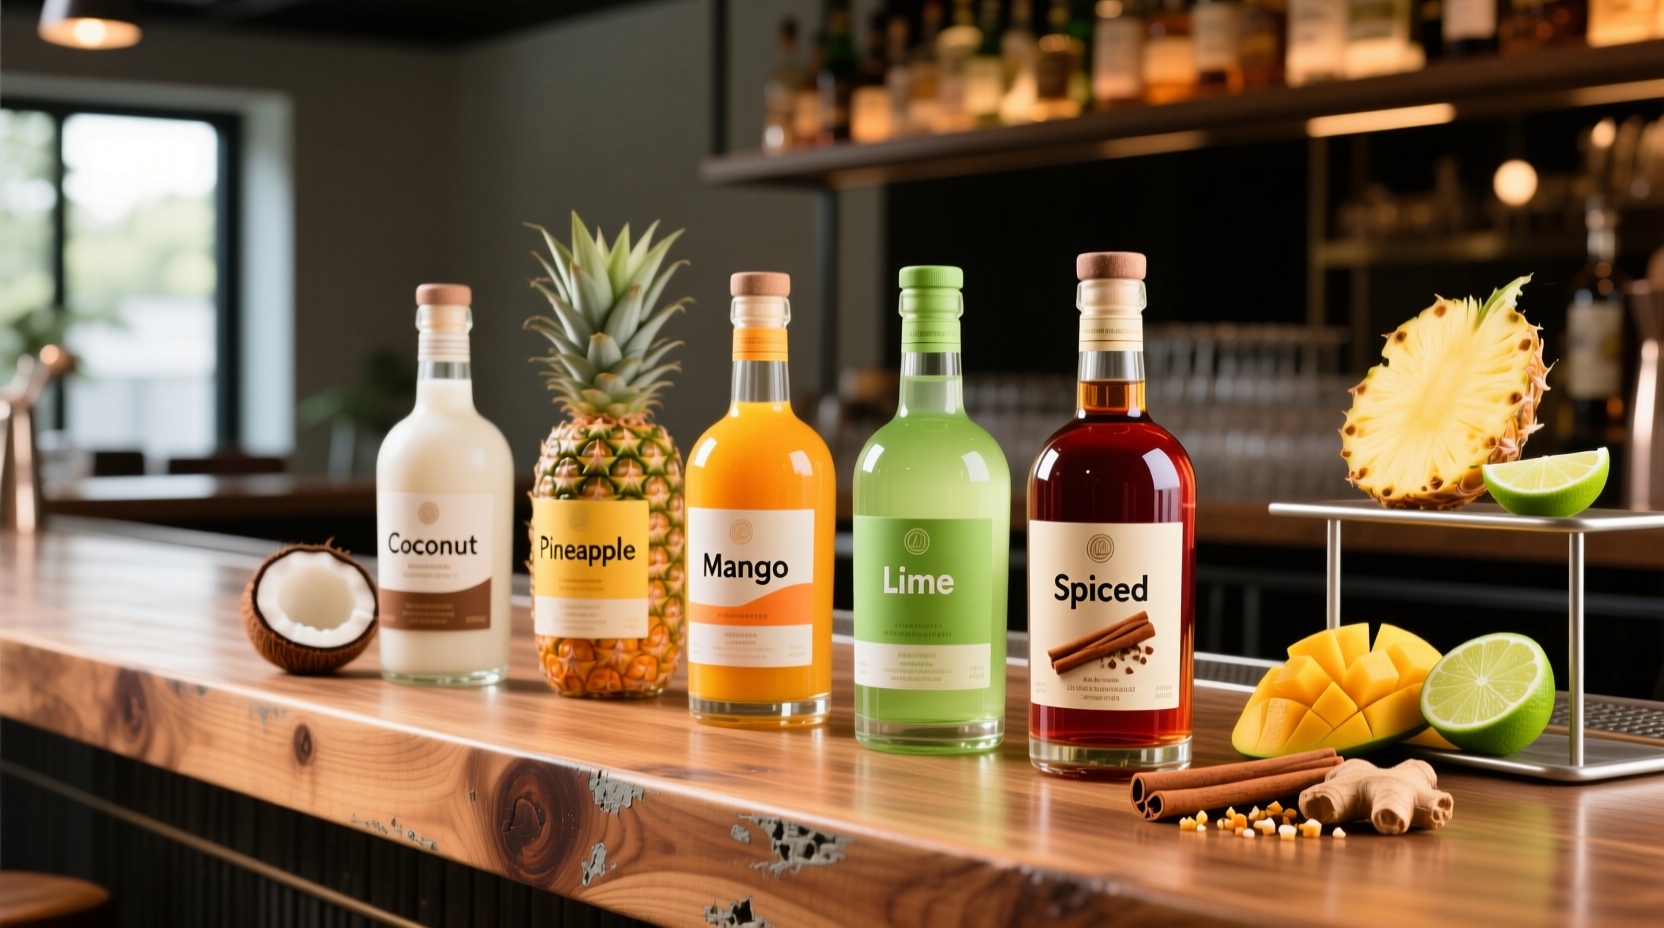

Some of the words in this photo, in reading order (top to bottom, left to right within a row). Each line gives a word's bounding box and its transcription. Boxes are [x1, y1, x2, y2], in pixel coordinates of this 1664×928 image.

[388, 532, 478, 556] Coconut
[540, 535, 636, 567] Pineapple
[703, 552, 789, 585] Mango
[883, 565, 955, 595] Lime
[1054, 574, 1149, 610] Spiced
